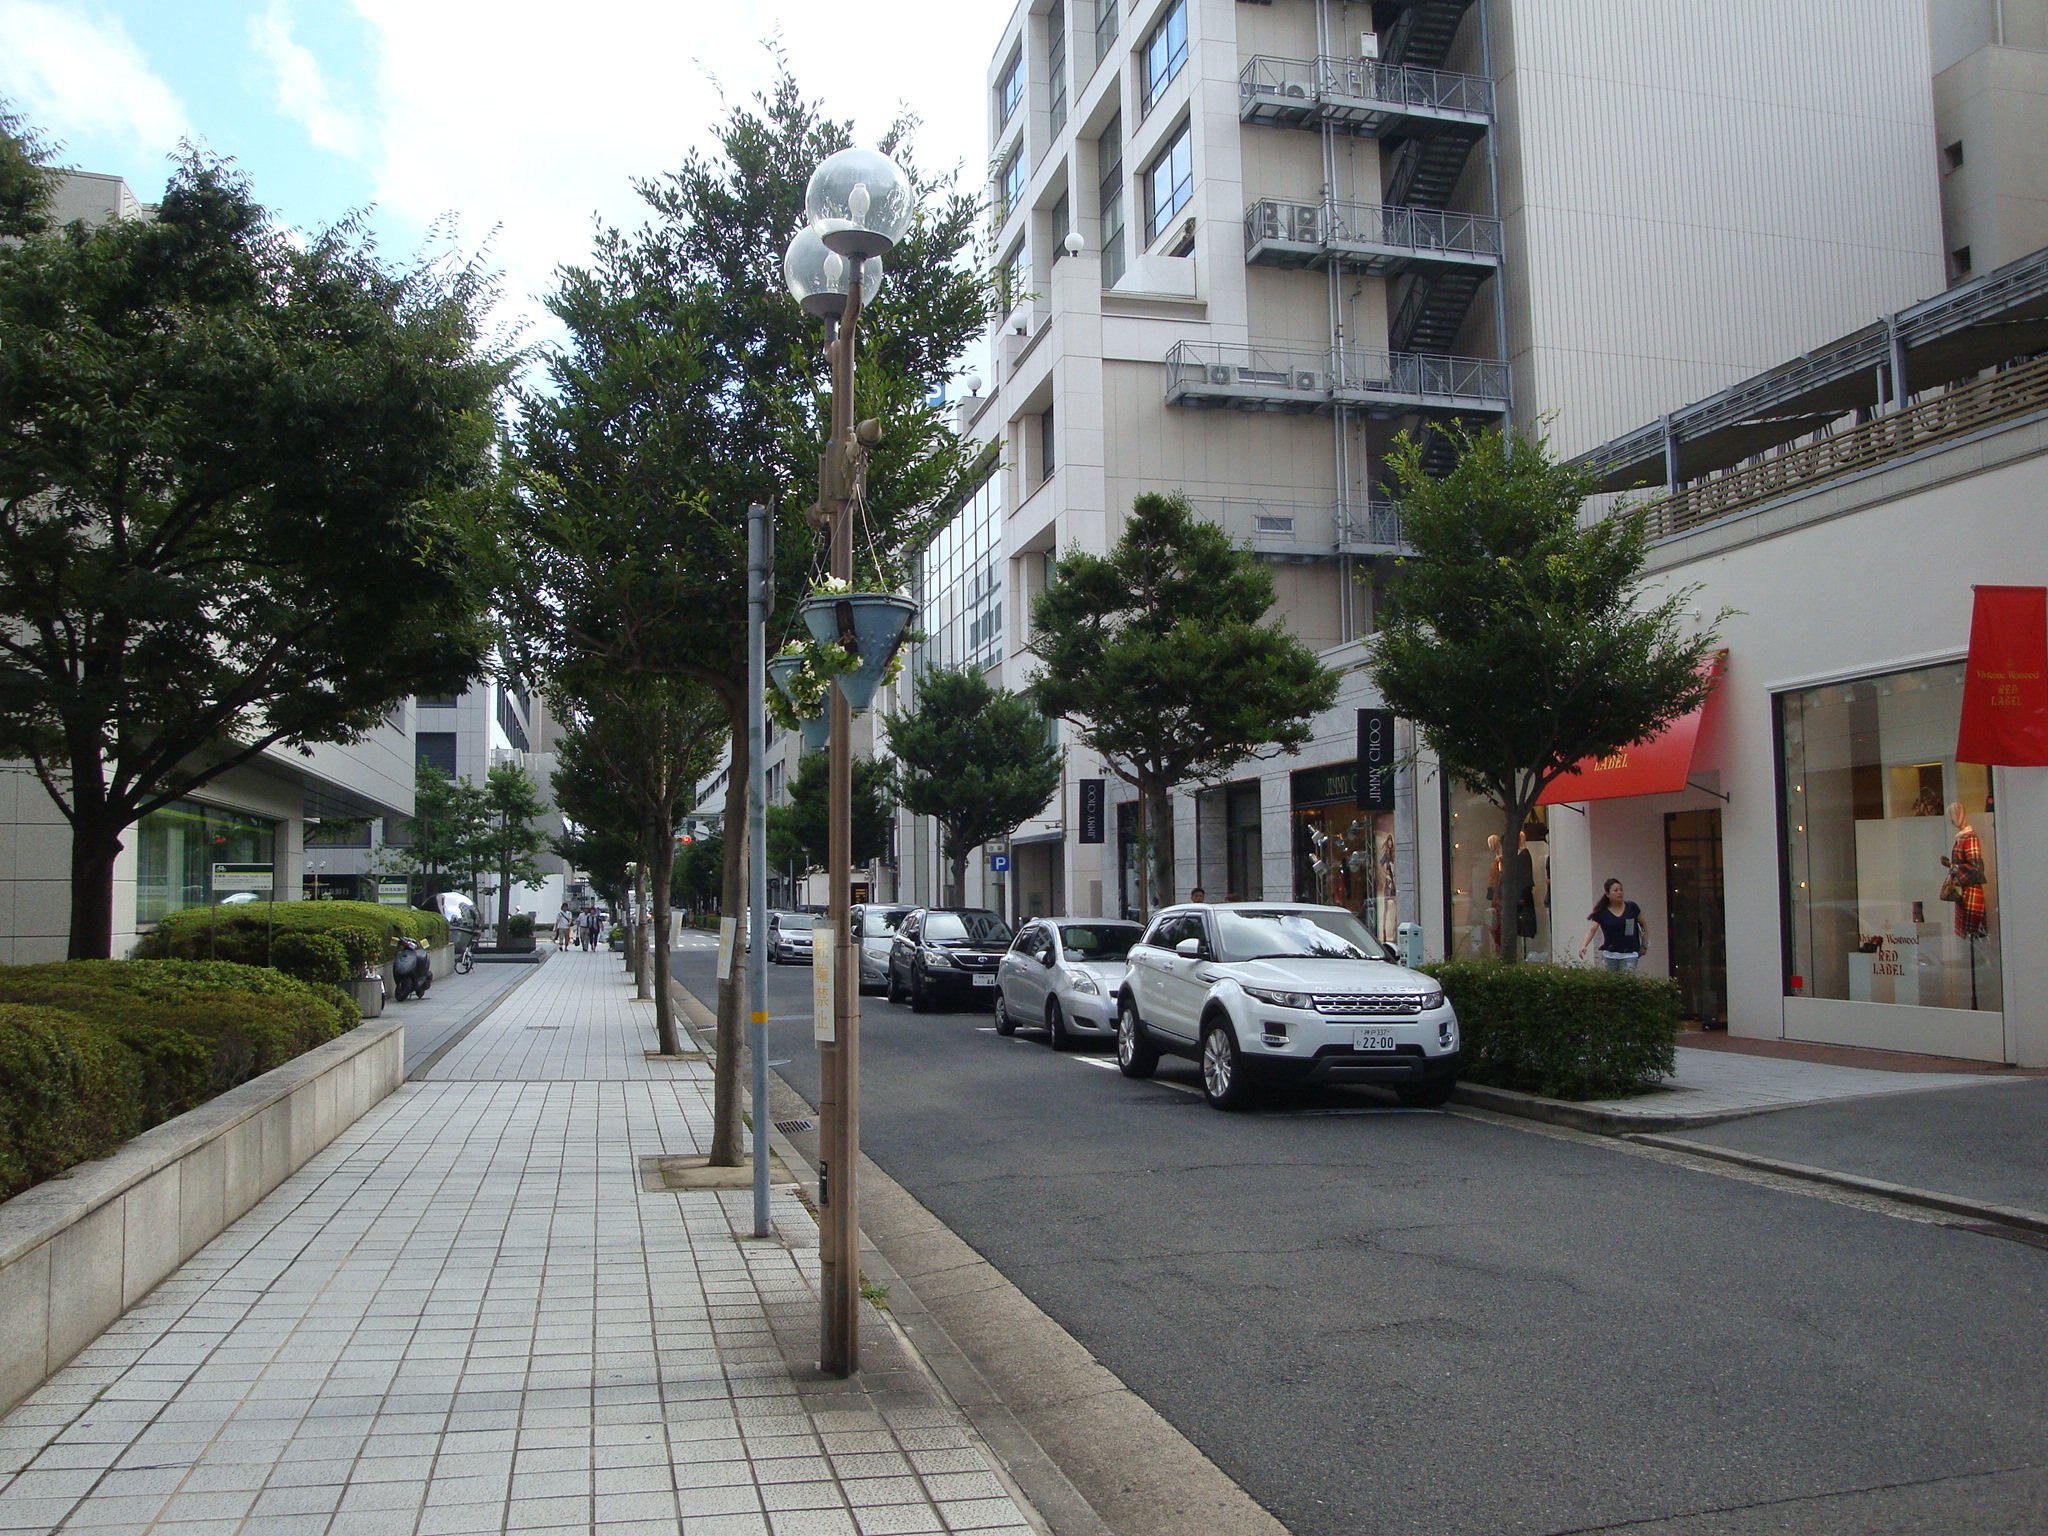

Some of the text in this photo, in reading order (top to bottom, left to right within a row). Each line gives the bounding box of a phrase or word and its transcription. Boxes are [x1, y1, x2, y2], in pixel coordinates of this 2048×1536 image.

[1998, 684, 2017, 694] RED
[1991, 696, 2022, 706] LABEL
[1369, 718, 1381, 802] JIMMY CHOO
[1594, 754, 1628, 771] LABEL
[1326, 775, 1349, 796] JIMMY
[1087, 784, 1096, 839] JIMMY CHOO
[996, 857, 1006, 870] P
[1885, 933, 1920, 945] Westwood
[1878, 949, 1899, 962] RED
[1872, 963, 1905, 976] LABEL
[815, 938, 829, 1029] 駐輪禁止
[1362, 1036, 1394, 1049] 22-00
